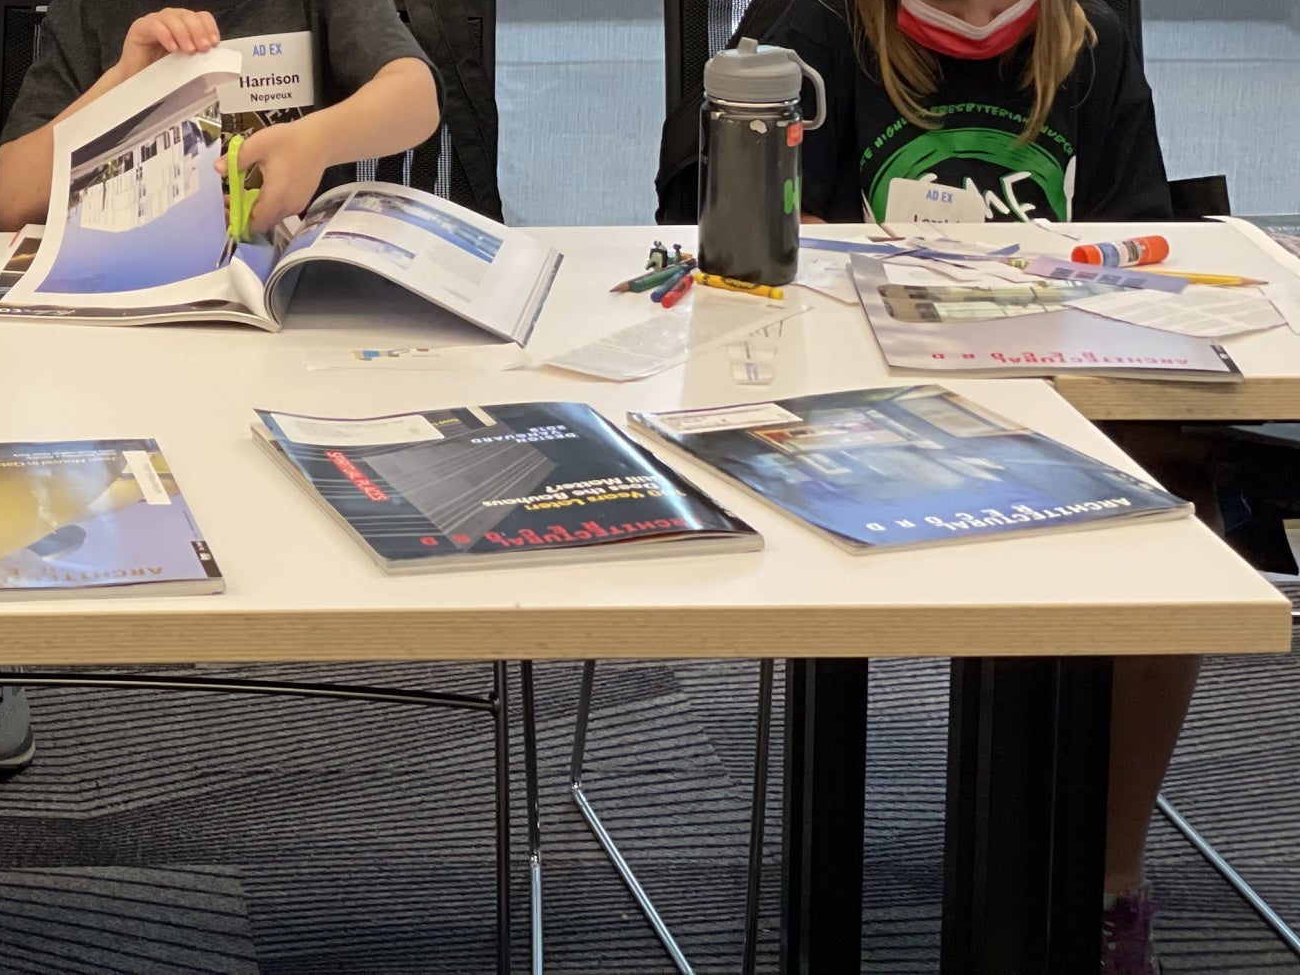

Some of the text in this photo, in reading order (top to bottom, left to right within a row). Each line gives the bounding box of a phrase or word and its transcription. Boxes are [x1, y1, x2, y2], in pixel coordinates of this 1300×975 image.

[252, 43, 282, 57] AD EX
[239, 73, 300, 88] Harrison
[250, 91, 293, 103] Nepveux
[925, 189, 953, 204] AD EX
[998, 356, 1189, 365] ARCHITECTURAL
[470, 430, 561, 444] VANGUARD
[516, 433, 579, 443] DESIGN
[545, 477, 622, 493] Matter?
[571, 486, 606, 496] the
[481, 491, 568, 507] Bauhaus
[587, 490, 645, 504] Years
[934, 497, 1132, 531] ARCHITECTURAL
